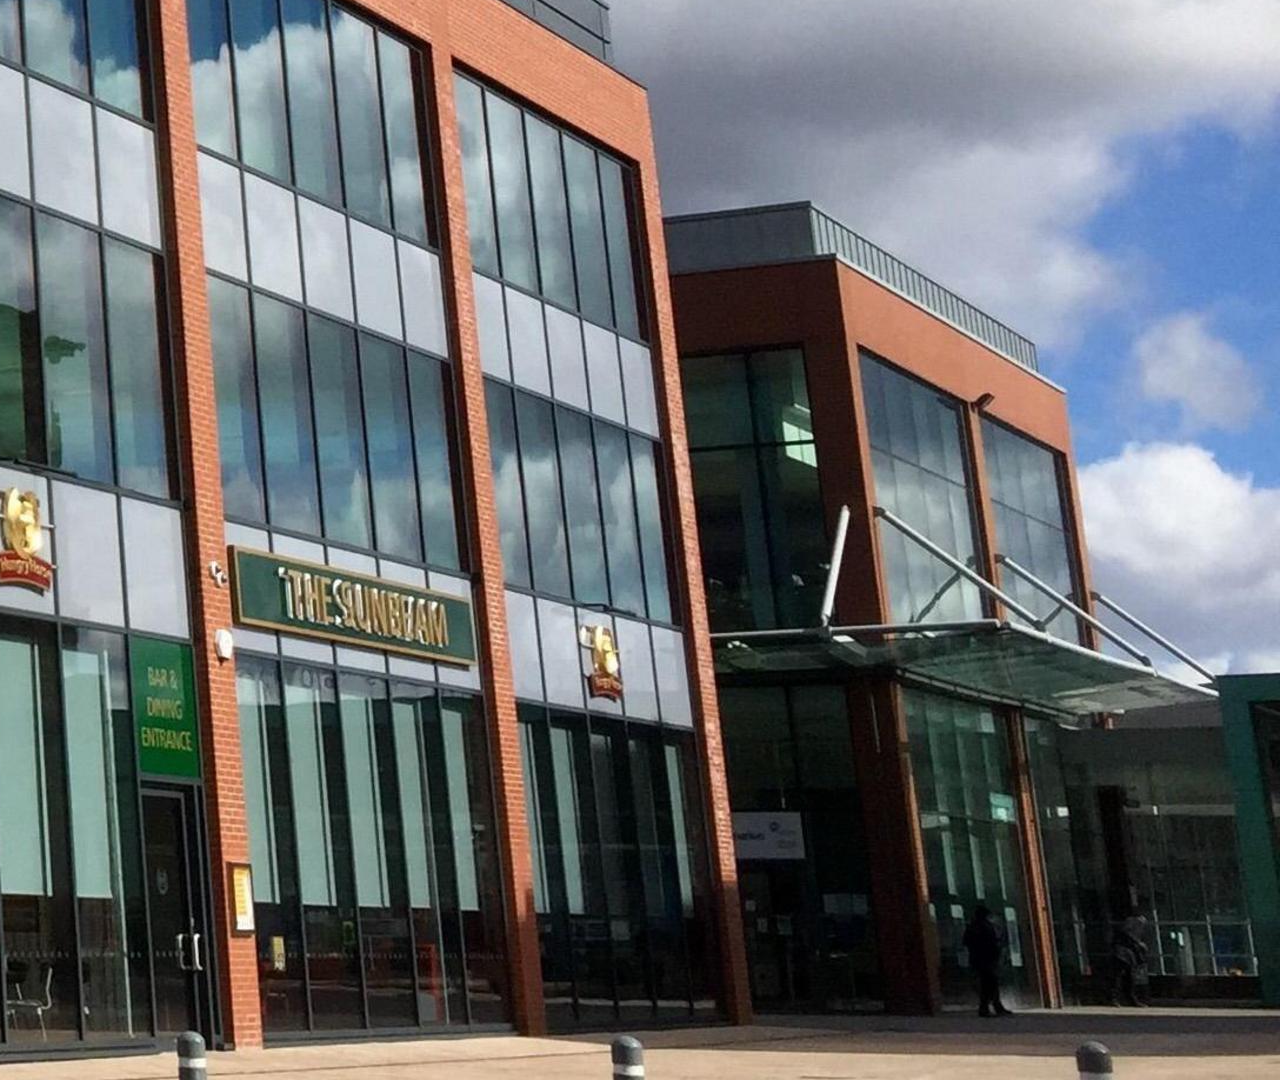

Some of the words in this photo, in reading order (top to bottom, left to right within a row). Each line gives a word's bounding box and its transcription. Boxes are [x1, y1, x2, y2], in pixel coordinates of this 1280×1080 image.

[278, 567, 335, 625] THE
[333, 579, 449, 648] SUNBEAM
[147, 667, 168, 687] BAR
[169, 670, 178, 689] &
[147, 697, 183, 719] DINING
[141, 727, 193, 751] ENTRANCE
